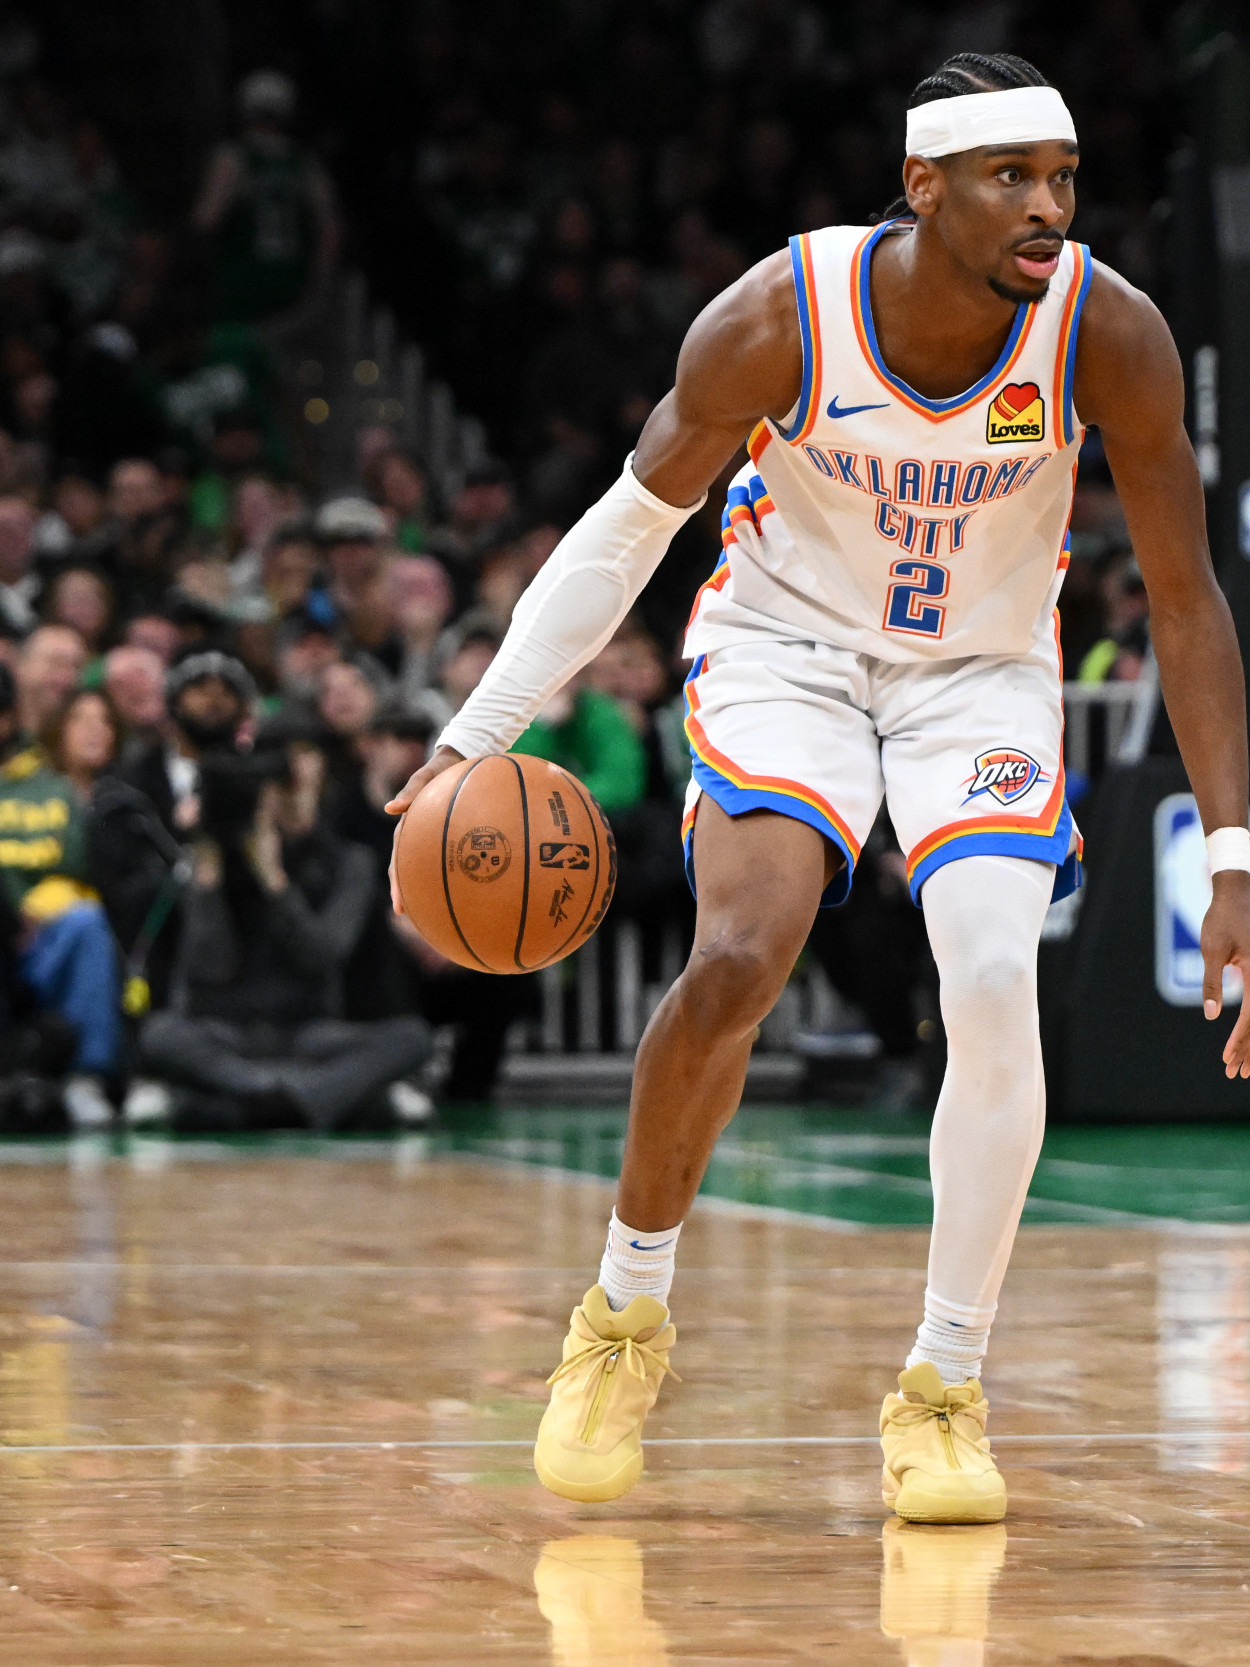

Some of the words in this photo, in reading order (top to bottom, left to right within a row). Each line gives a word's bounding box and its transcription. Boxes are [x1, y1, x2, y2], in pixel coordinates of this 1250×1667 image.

[801, 443, 1052, 508] OKLAHOMA
[874, 499, 979, 558] CITY
[882, 558, 950, 639] 2
[968, 761, 1029, 794] OKC
